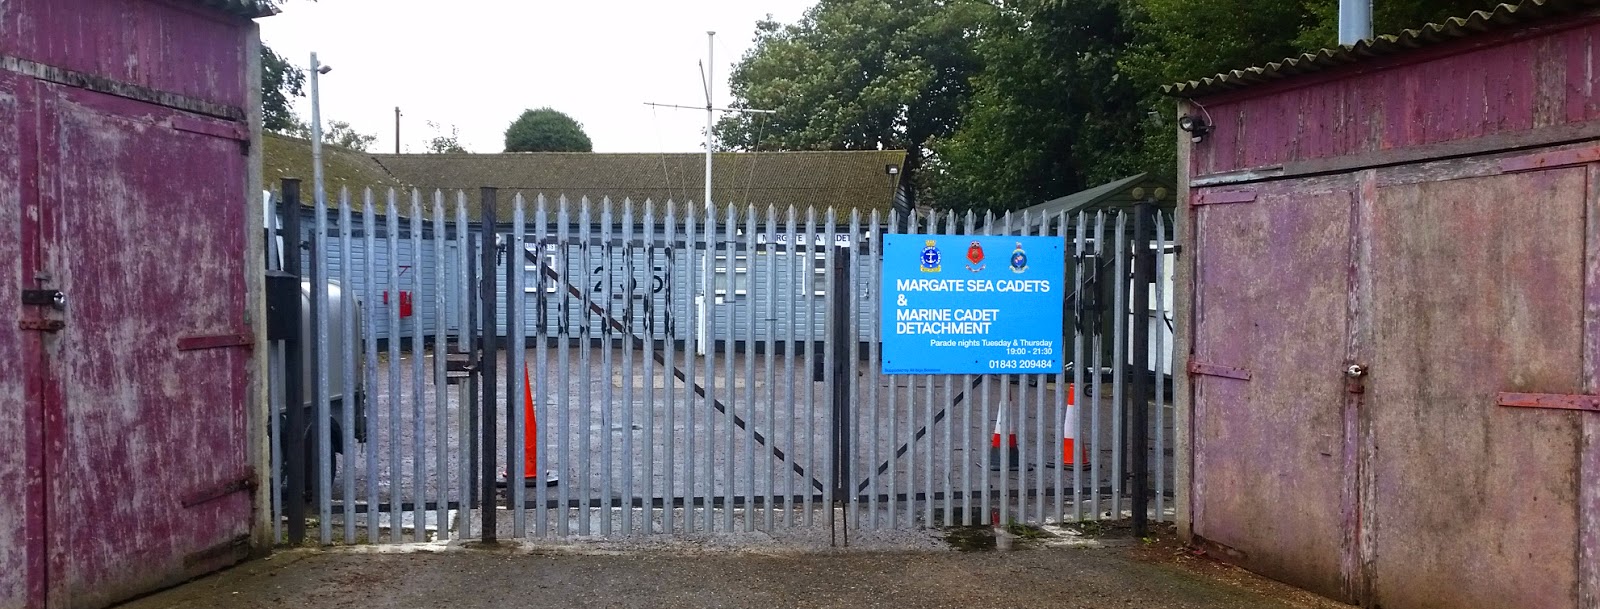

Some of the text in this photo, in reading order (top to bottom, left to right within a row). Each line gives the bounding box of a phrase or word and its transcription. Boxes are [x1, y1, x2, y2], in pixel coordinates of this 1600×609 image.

[896, 279, 1050, 293] MARGATE SEA CADETS
[897, 294, 908, 306] &
[896, 309, 999, 321] MARINE CADET
[896, 322, 992, 334] DETACHMENT
[958, 339, 980, 348] nights
[981, 339, 1011, 348] Tuesday
[1020, 339, 1053, 348] Thursday
[989, 360, 1052, 368] 01843 209484
